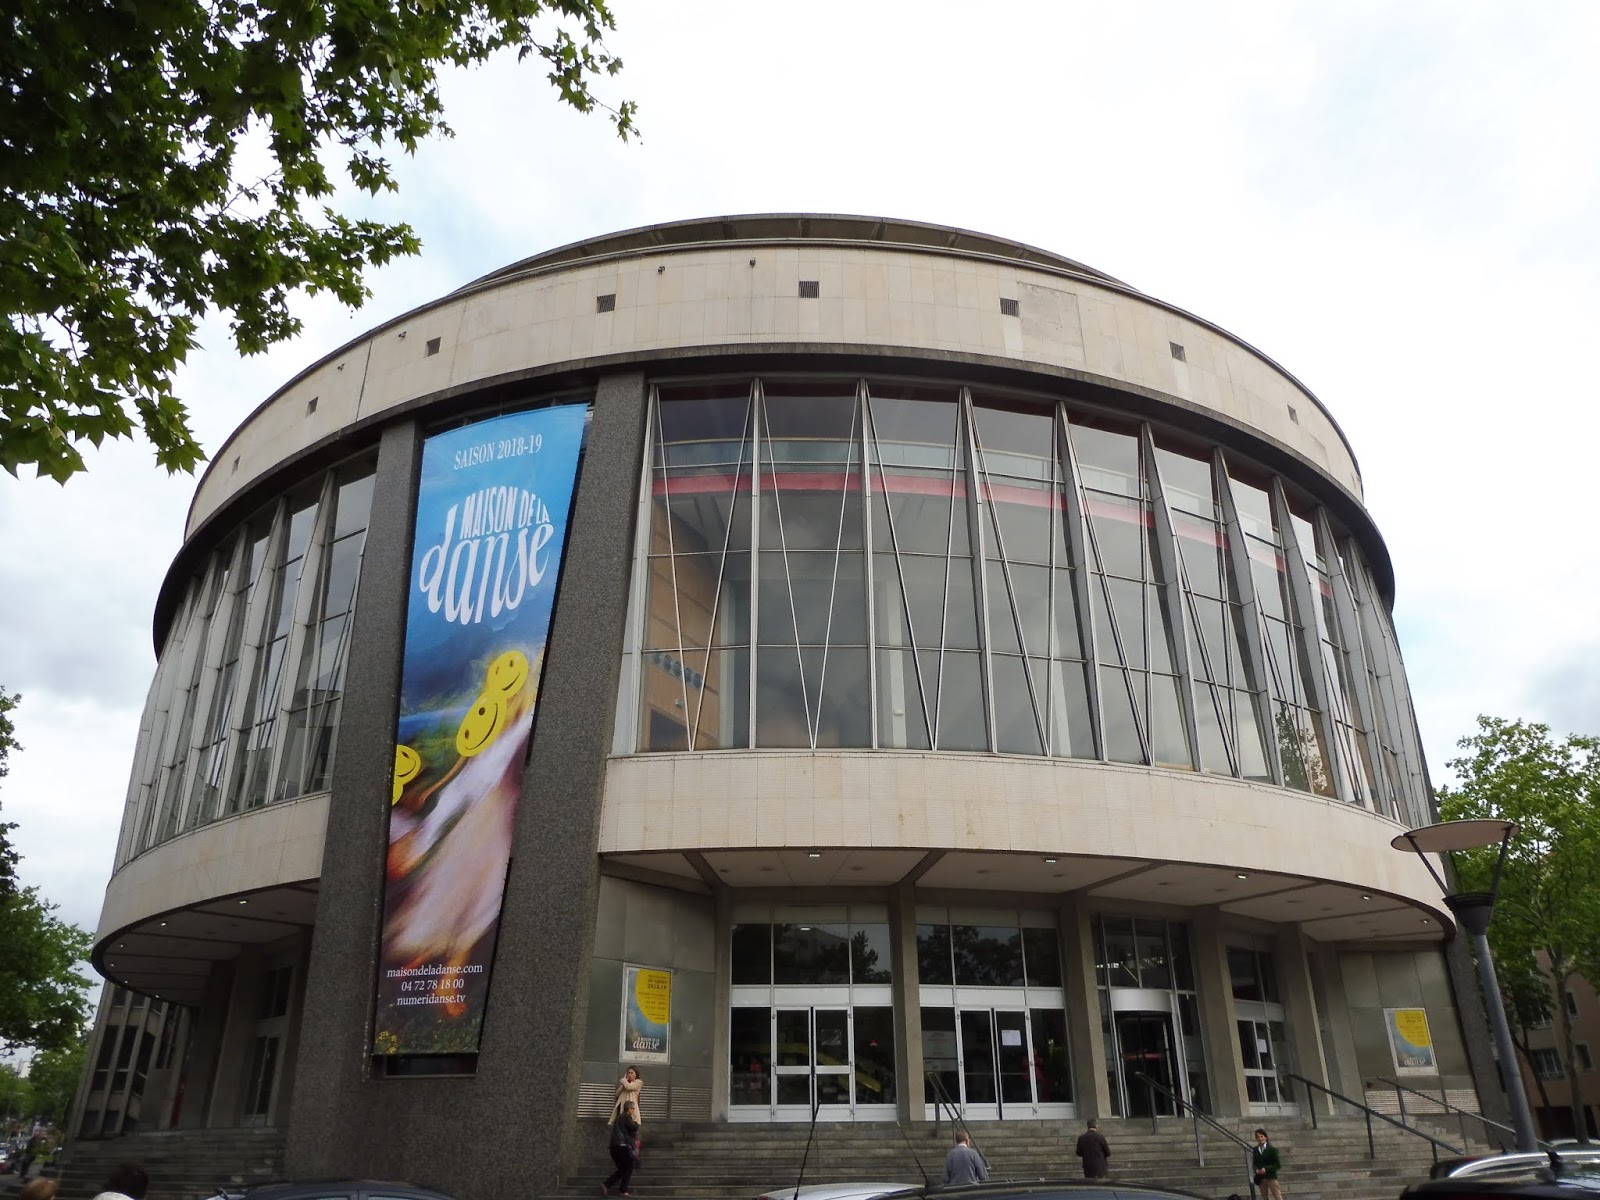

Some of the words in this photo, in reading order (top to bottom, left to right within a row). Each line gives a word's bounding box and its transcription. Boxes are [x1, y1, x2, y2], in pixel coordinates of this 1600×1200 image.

[454, 443, 494, 470] SAISON
[497, 434, 543, 459] 2018-19
[459, 486, 518, 539] MAISON
[518, 489, 536, 527] DE
[535, 498, 551, 524] LA
[419, 504, 554, 625] danse
[386, 964, 483, 978] maisondeladanse.com
[401, 981, 412, 992] 04
[414, 980, 425, 991] 72
[427, 980, 438, 990] 78
[441, 979, 451, 989] 18
[453, 978, 464, 989] 00
[396, 993, 466, 1006] numeridanse.tv
[632, 1037, 660, 1050] danse
